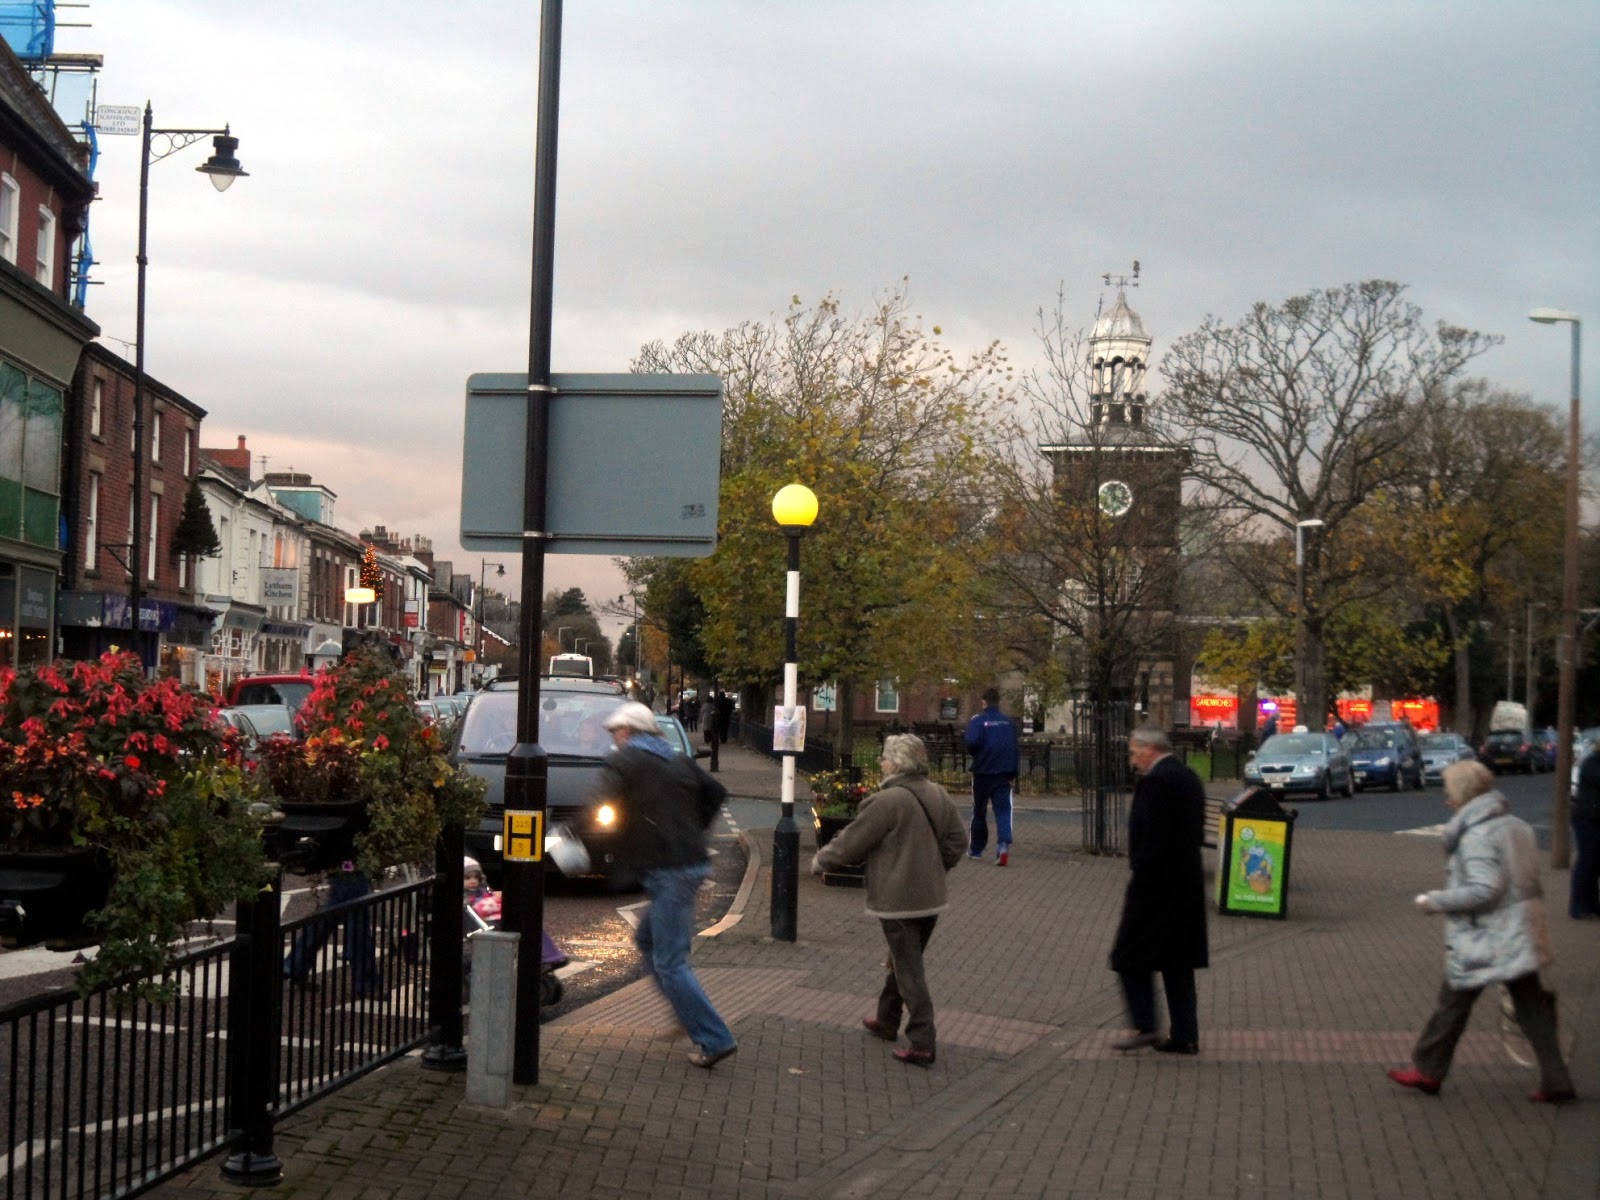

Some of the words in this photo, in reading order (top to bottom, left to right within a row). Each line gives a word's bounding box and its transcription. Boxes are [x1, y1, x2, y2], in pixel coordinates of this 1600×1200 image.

[264, 581, 293, 590] Lytham
[264, 590, 293, 598] Kitchen
[1195, 698, 1233, 707] SANDWICHES
[508, 816, 536, 856] H
